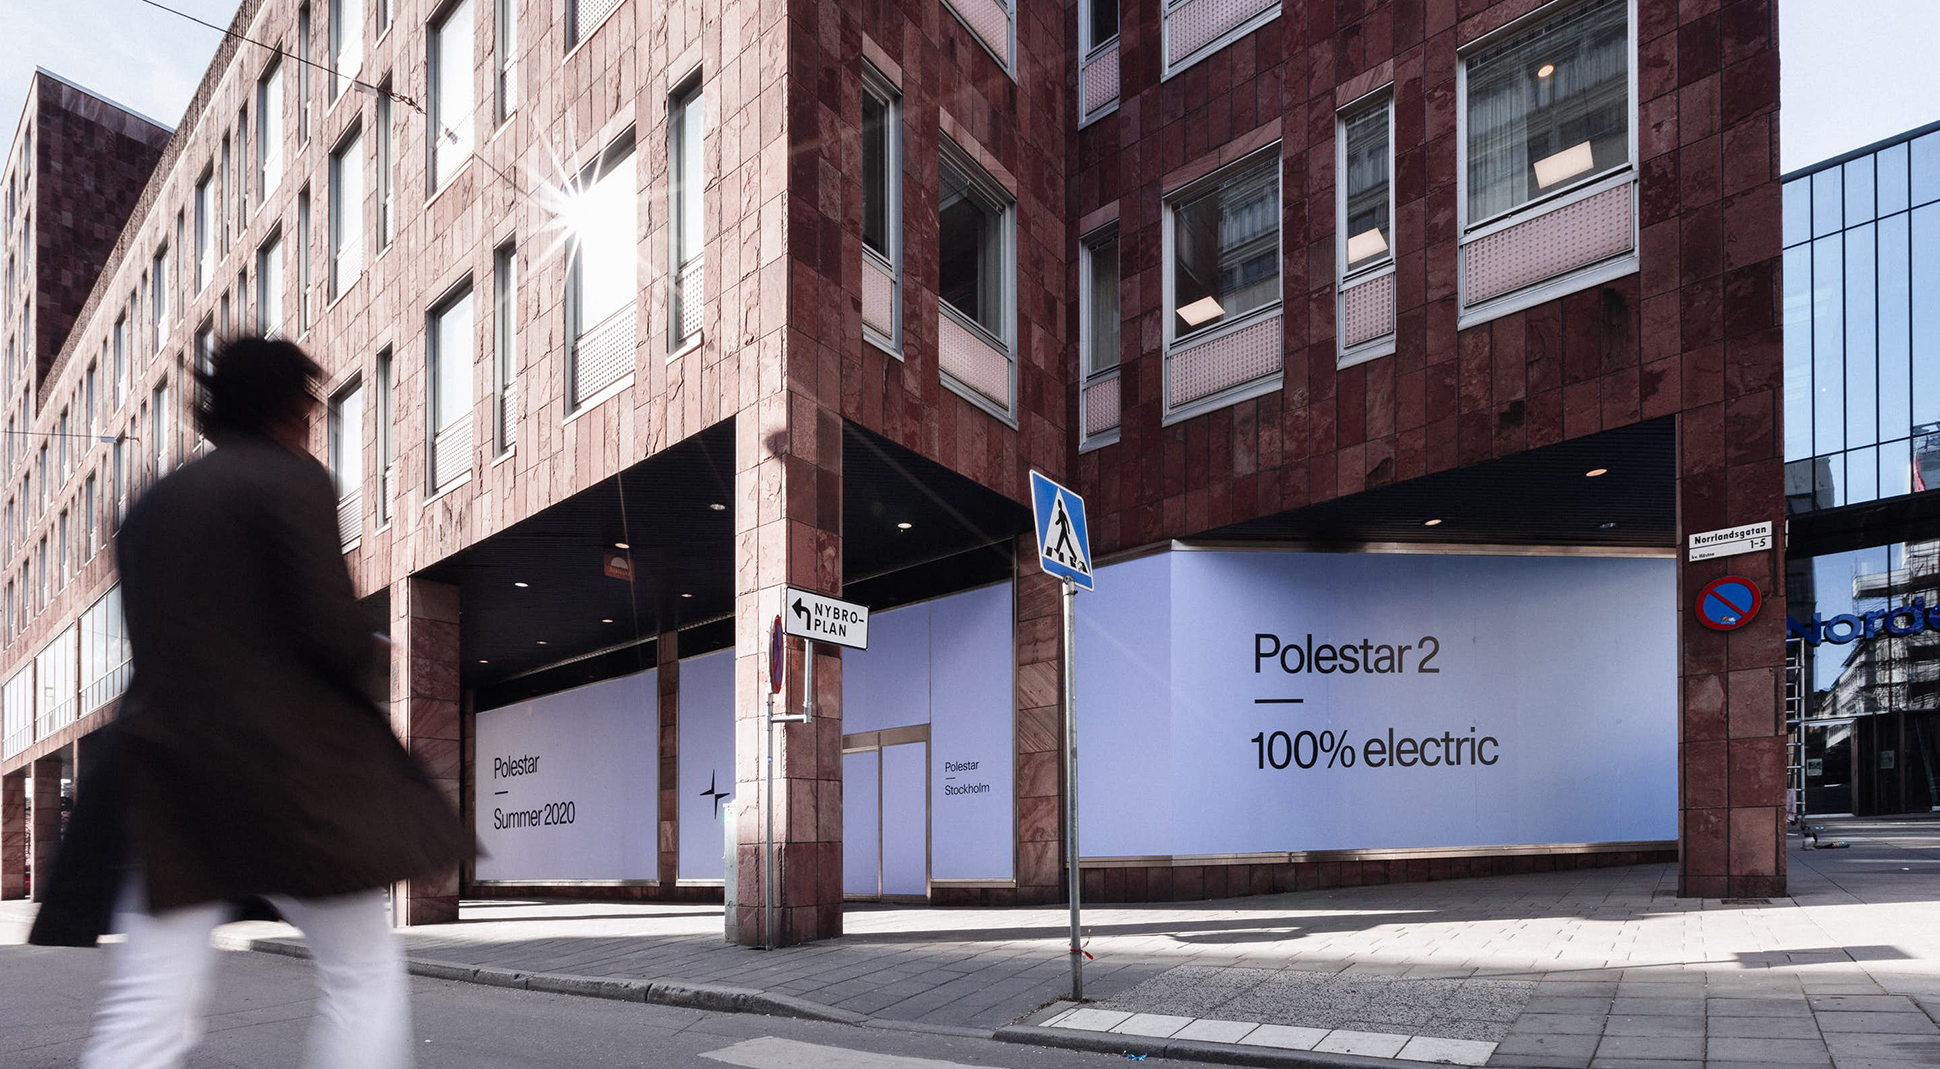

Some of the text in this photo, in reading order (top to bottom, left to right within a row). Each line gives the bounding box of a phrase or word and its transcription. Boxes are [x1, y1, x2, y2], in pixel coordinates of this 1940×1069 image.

[1694, 526, 1767, 545] Norrlandsgatan
[1750, 537, 1766, 549] 1-5
[814, 602, 865, 624] NYBRO-
[814, 618, 847, 637] PLAN
[1254, 633, 1440, 674] Polestar 2
[1251, 726, 1499, 770] 100% electric
[494, 754, 540, 779] Polestar
[945, 761, 980, 772] Polestar
[945, 782, 990, 796] Stockholm
[494, 801, 576, 830] Summer 2020
